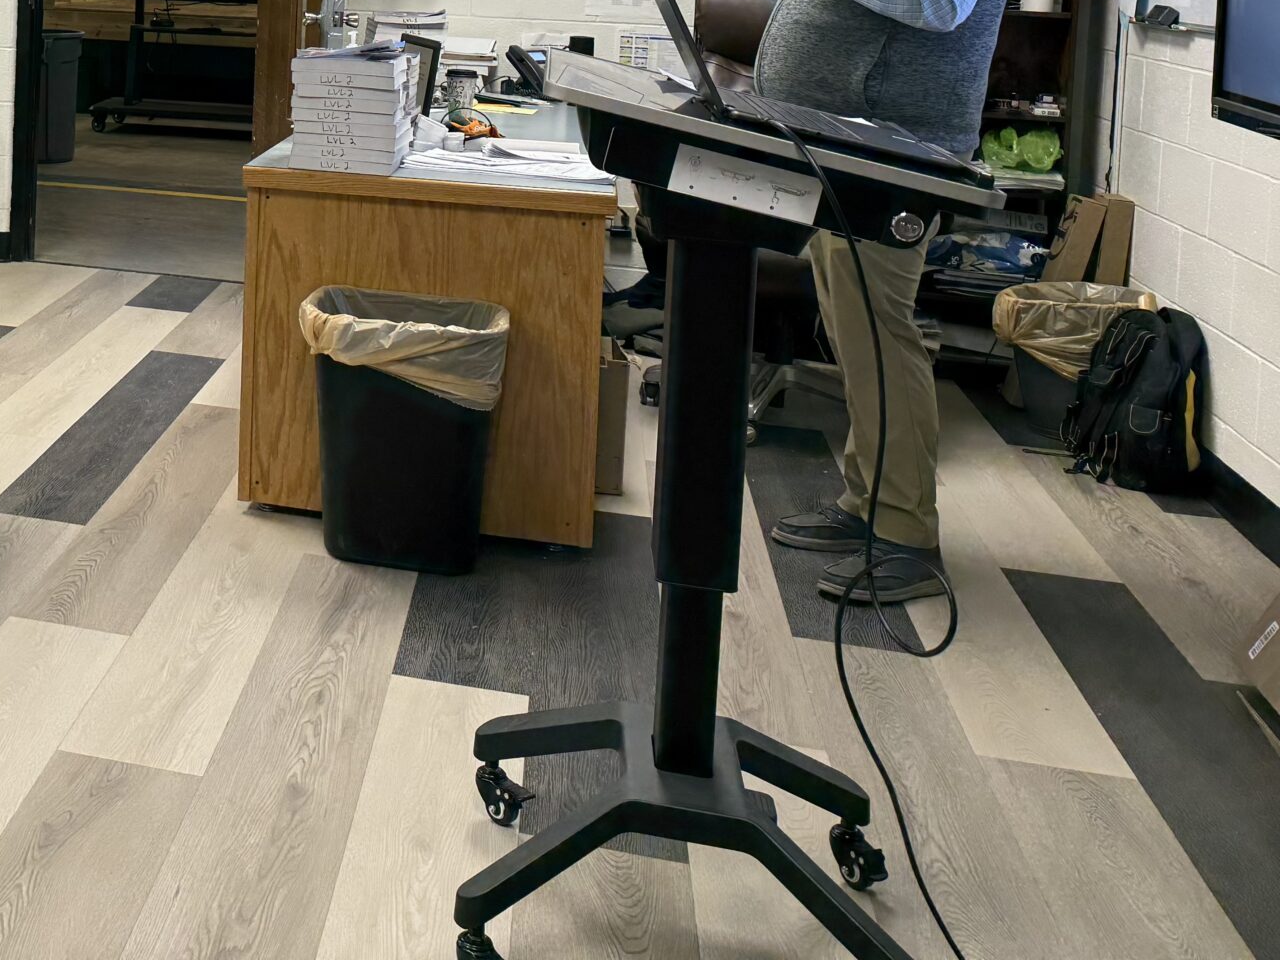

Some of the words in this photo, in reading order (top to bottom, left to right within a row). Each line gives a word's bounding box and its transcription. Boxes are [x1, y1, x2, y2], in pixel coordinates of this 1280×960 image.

[320, 74, 342, 84] LVL
[327, 88, 346, 96] LVL
[324, 100, 344, 108] LVL
[317, 112, 340, 120] LVL
[322, 122, 344, 133] LVL
[327, 136, 345, 144] LVL
[321, 148, 338, 157] LVL
[321, 161, 340, 169] LVL
